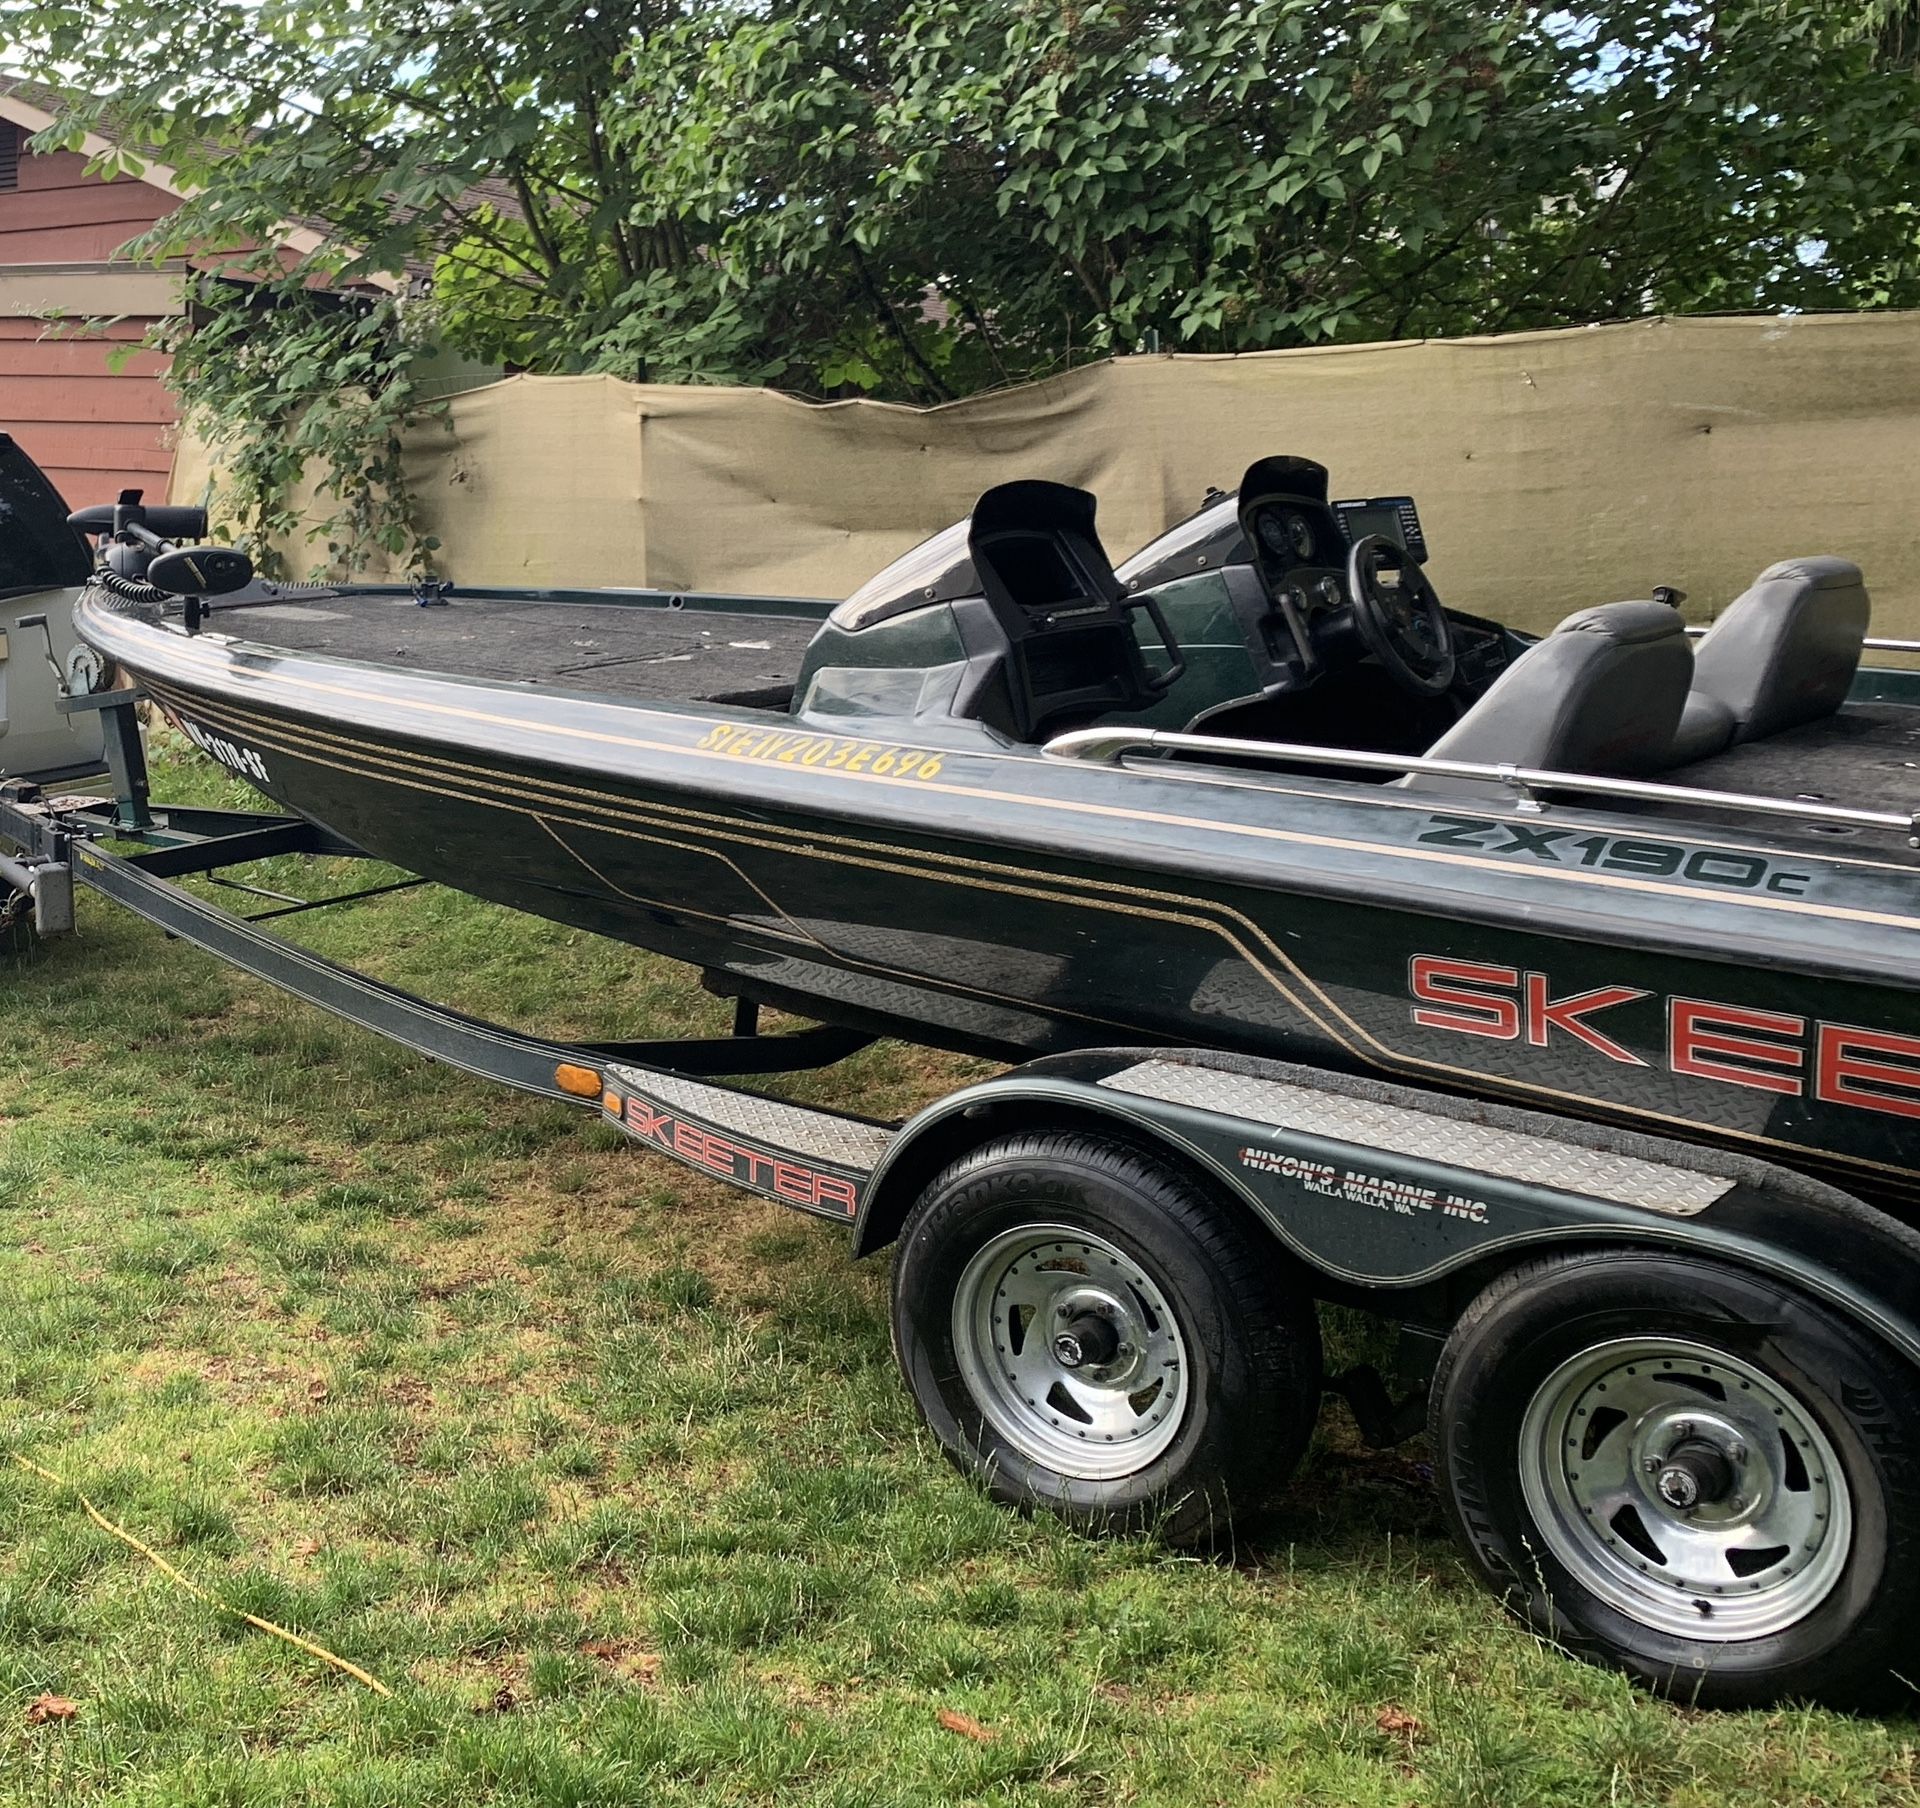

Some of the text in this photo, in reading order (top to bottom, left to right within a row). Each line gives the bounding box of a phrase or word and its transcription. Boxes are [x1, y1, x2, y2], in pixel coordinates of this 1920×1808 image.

[1408, 953, 1920, 1119] SKEE
[627, 1096, 856, 1216] SKEETER
[1242, 1147, 1490, 1225] NIXON'S MARINE INC.
[1303, 1180, 1416, 1216] WALLA WALLA, WA.
